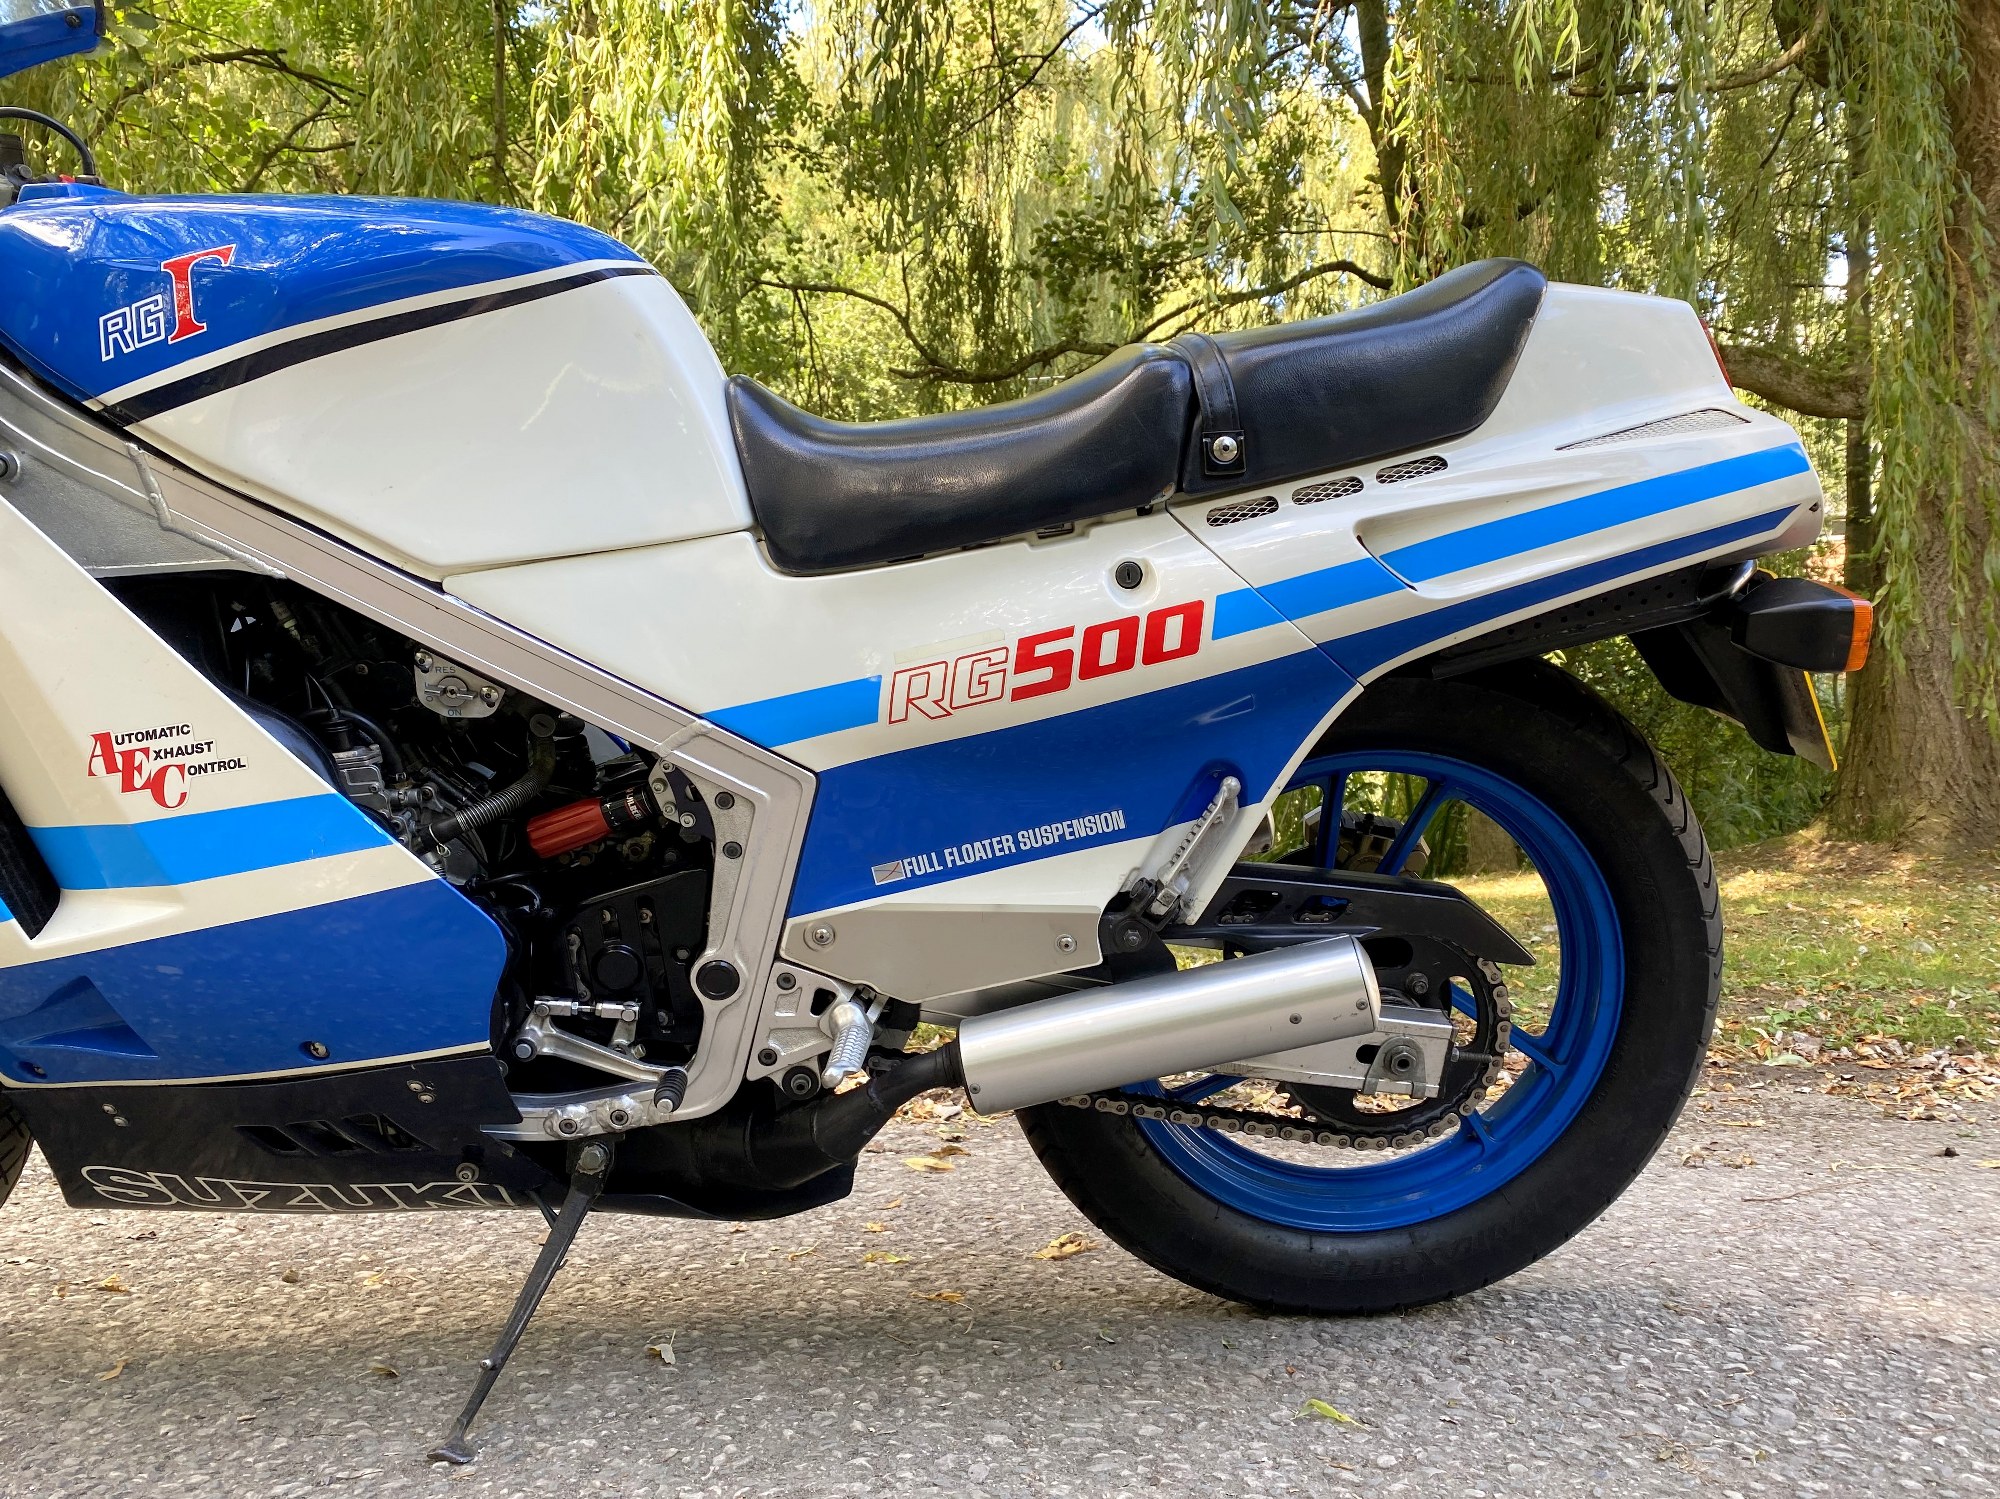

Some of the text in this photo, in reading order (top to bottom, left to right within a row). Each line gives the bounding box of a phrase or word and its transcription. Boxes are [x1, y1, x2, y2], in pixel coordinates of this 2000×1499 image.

[435, 666, 456, 674] RES
[447, 709, 462, 717] ON
[88, 724, 191, 776] AUTOMATIC
[114, 741, 214, 793] EXHAUST
[150, 758, 247, 808] CONTROL
[903, 809, 1127, 878] FULL FLOATER SUSPENSION
[81, 1165, 516, 1211] SUZUKI
